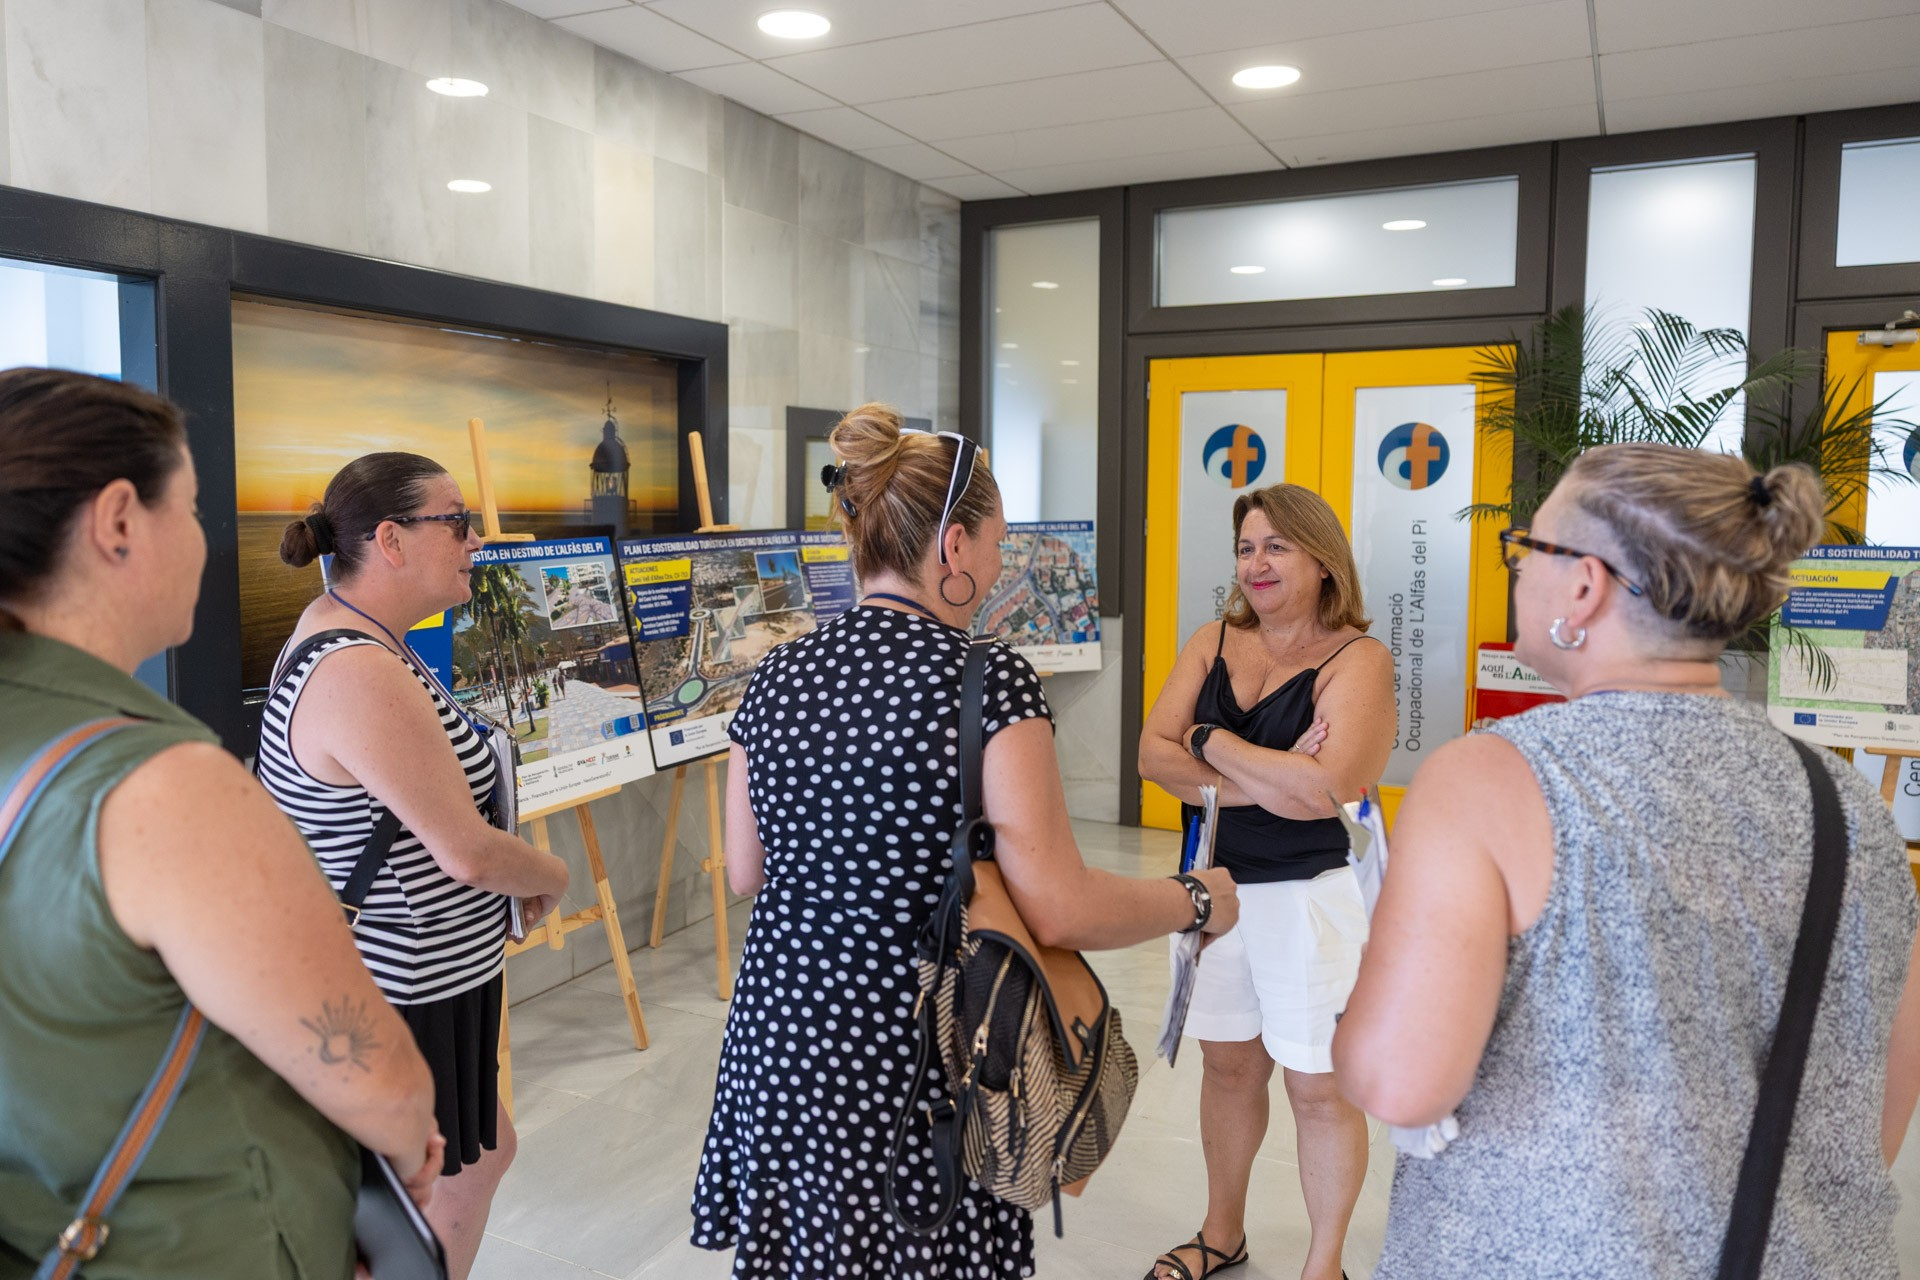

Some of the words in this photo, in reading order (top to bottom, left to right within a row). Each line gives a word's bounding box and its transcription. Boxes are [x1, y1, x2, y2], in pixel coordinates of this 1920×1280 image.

[1412, 519, 1427, 535] Pi
[499, 549, 511, 560] EN
[511, 546, 543, 559] DESTINO
[543, 545, 555, 557] DE
[582, 542, 595, 553] DEL
[595, 541, 604, 552] PI
[623, 545, 642, 556] PLAN
[643, 544, 651, 554] DE
[651, 540, 699, 554] SOSTENIBILIDAD
[1411, 541, 1427, 565] del
[1812, 548, 1825, 557] DE
[1827, 549, 1911, 559] SOSTENIBILIDAD
[1791, 574, 1838, 583] ACTUACIÓN
[1409, 628, 1424, 648] de
[1405, 653, 1425, 752] Ocupacional
